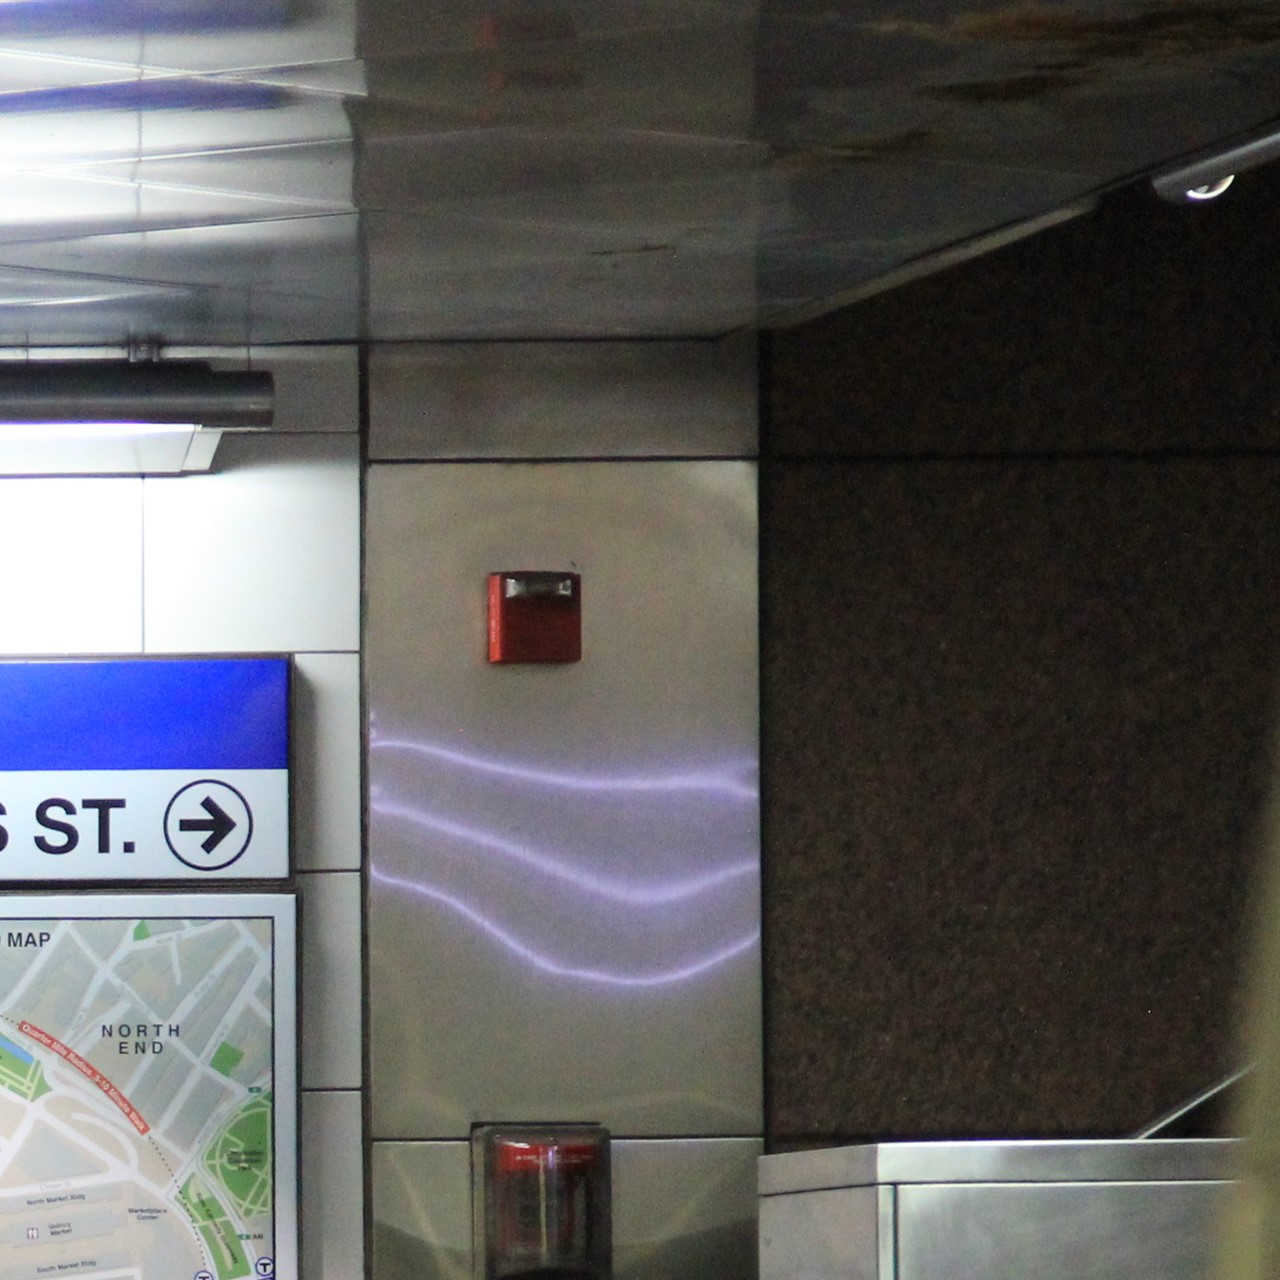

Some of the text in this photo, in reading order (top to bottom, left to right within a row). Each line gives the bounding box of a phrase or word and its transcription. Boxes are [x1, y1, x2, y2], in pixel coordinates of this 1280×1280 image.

[34, 797, 136, 855] ST.
[7, 933, 51, 948] MAP
[102, 1025, 180, 1038] NORTH
[119, 1042, 164, 1054] END
[22, 1023, 52, 1046] Quarter
[52, 1041, 68, 1057] Mile
[92, 1073, 110, 1091] 5-10
[109, 1088, 131, 1114] Minute
[129, 1111, 146, 1131] Walk
[46, 1196, 67, 1204] Market
[49, 1223, 71, 1231] Quincy
[50, 1229, 72, 1237] Market
[58, 1263, 79, 1271] Market
